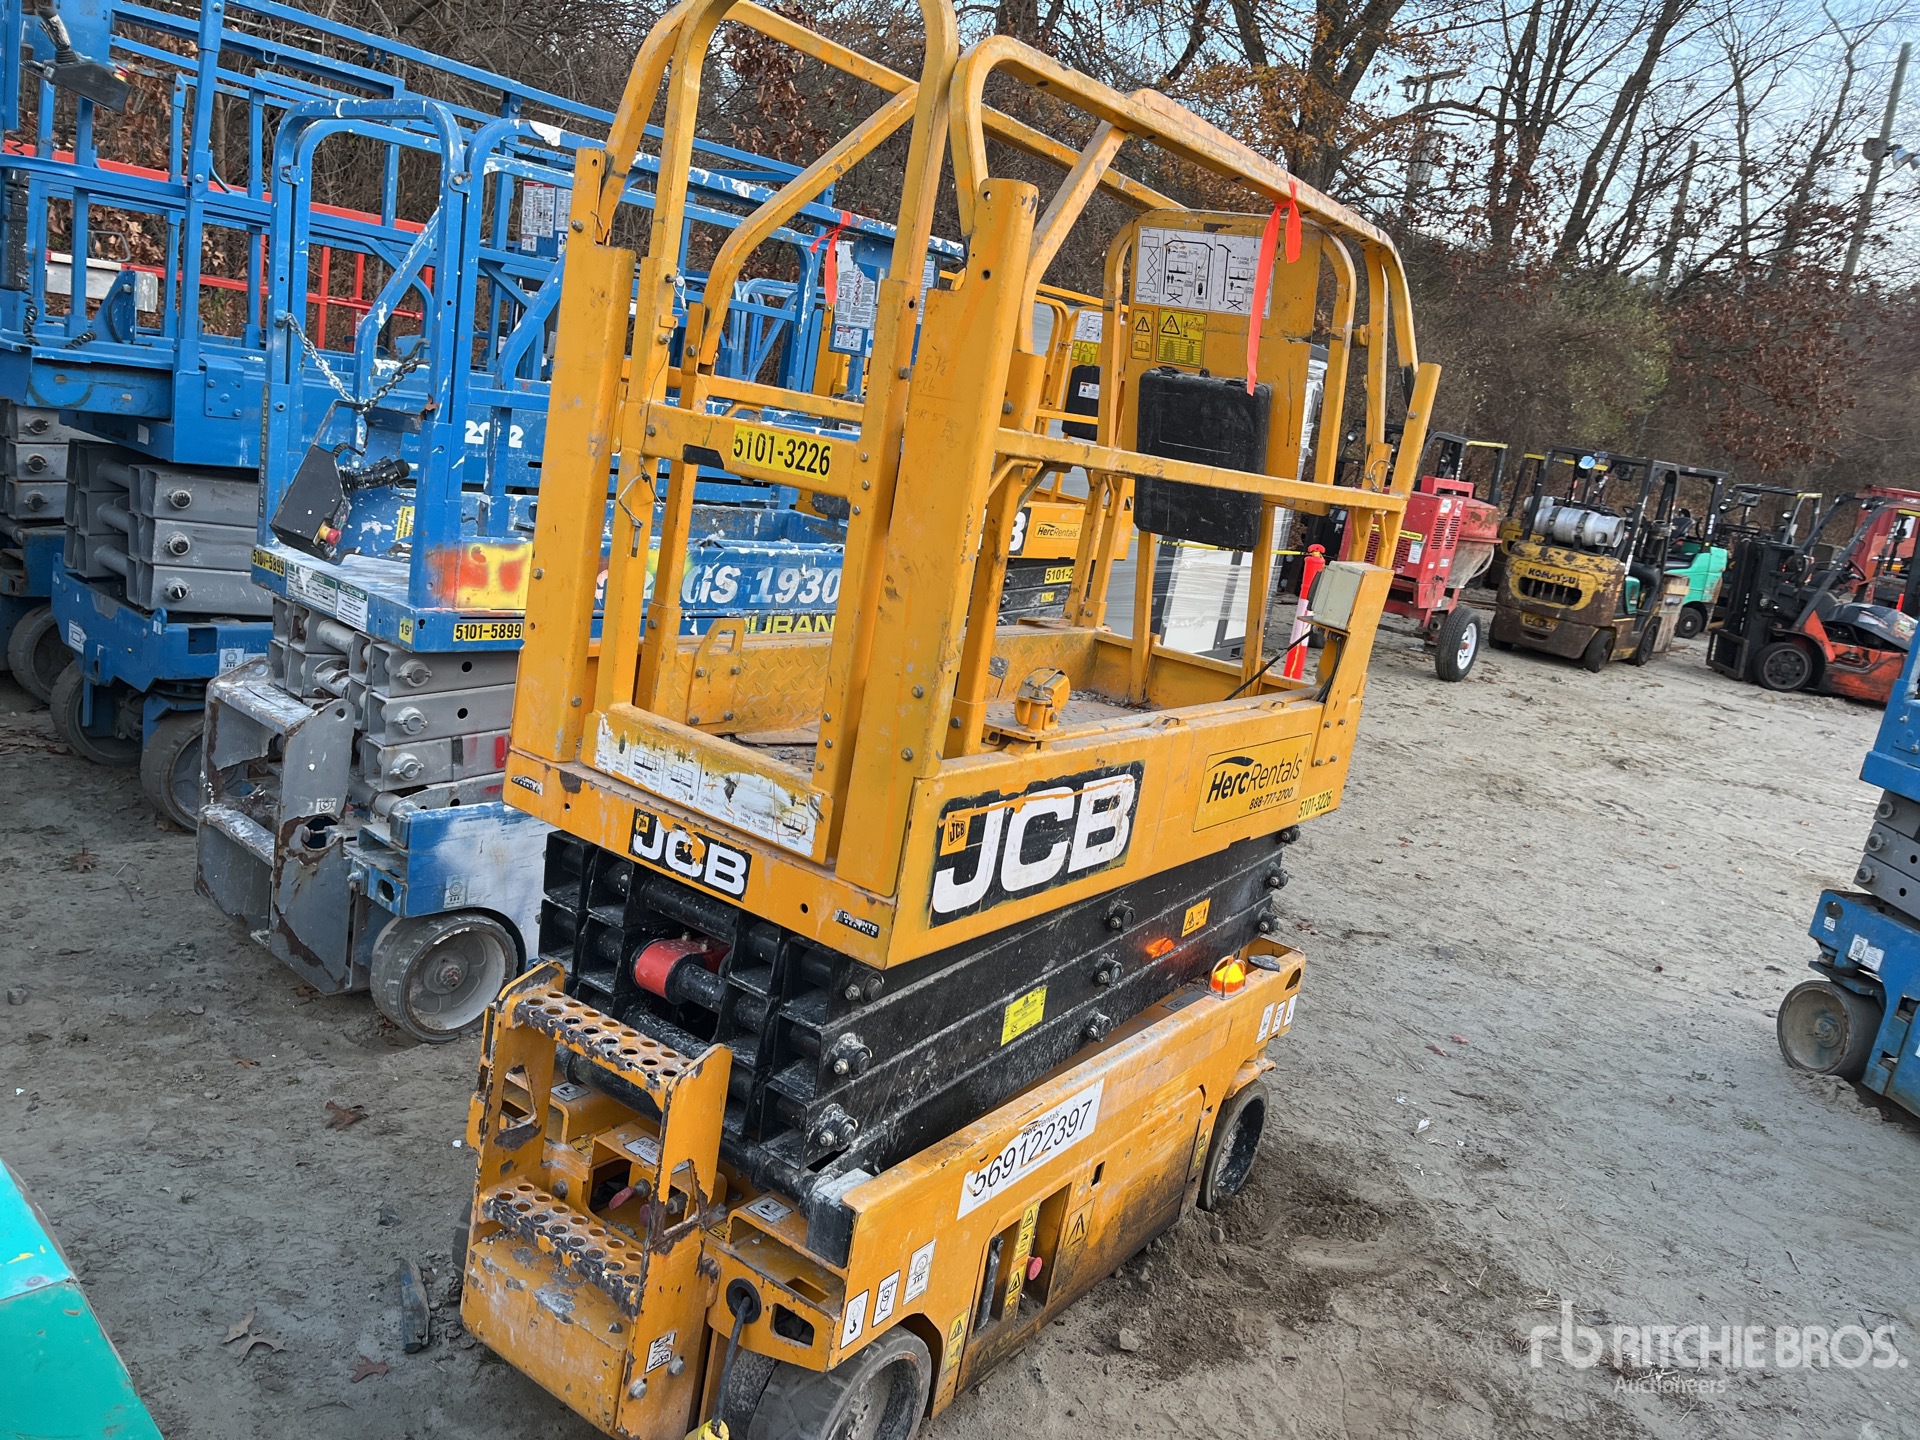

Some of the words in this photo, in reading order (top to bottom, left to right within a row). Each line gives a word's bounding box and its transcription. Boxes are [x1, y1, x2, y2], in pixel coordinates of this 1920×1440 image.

[464, 419, 524, 449] 22
[733, 432, 831, 476] 5101-3226
[1036, 525, 1079, 538] HercRentals
[750, 565, 841, 605] 1930
[455, 623, 521, 640] 5101-5899
[1206, 752, 1303, 804] HercRentals
[1248, 786, 1294, 810] 888-777-2700
[1297, 790, 1334, 819] 5101-3226
[932, 774, 1136, 914] JCB
[949, 820, 966, 842] JCB
[632, 815, 748, 895] JCB
[968, 1099, 1092, 1197] 569122397
